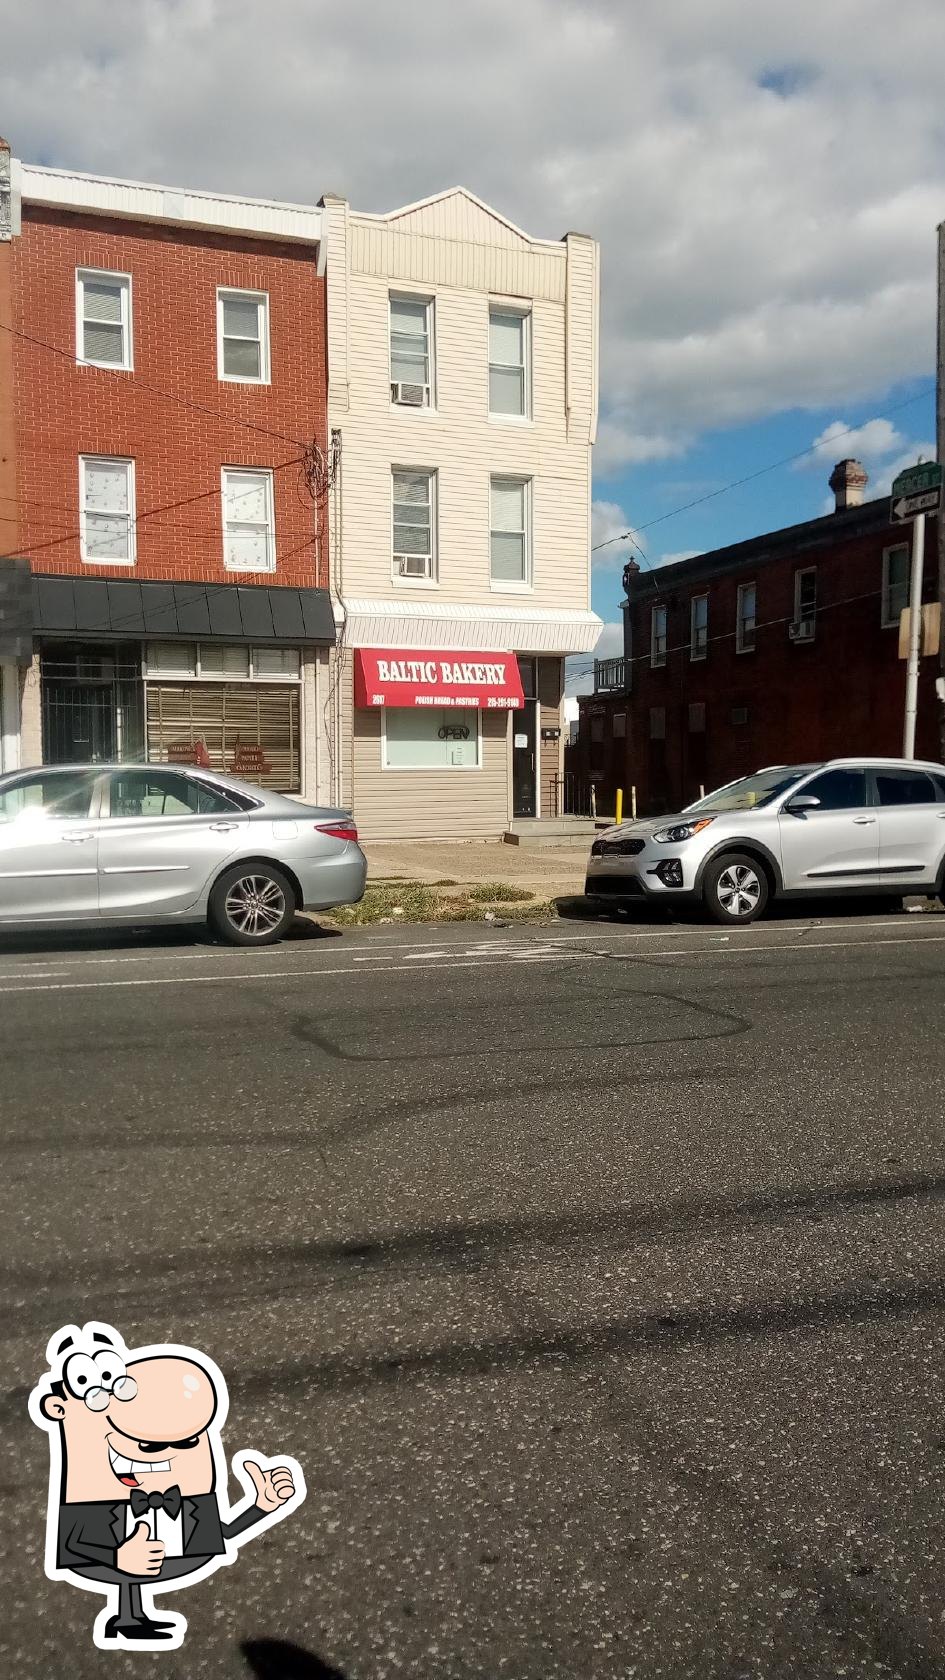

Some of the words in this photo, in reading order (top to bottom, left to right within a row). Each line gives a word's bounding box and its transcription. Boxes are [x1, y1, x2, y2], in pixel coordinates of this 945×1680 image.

[377, 660, 437, 683] BALTIC
[440, 663, 506, 685] BAKERY
[415, 696, 433, 705] POLISH
[456, 697, 479, 706] PASTRIES
[438, 726, 470, 740] OPEN
